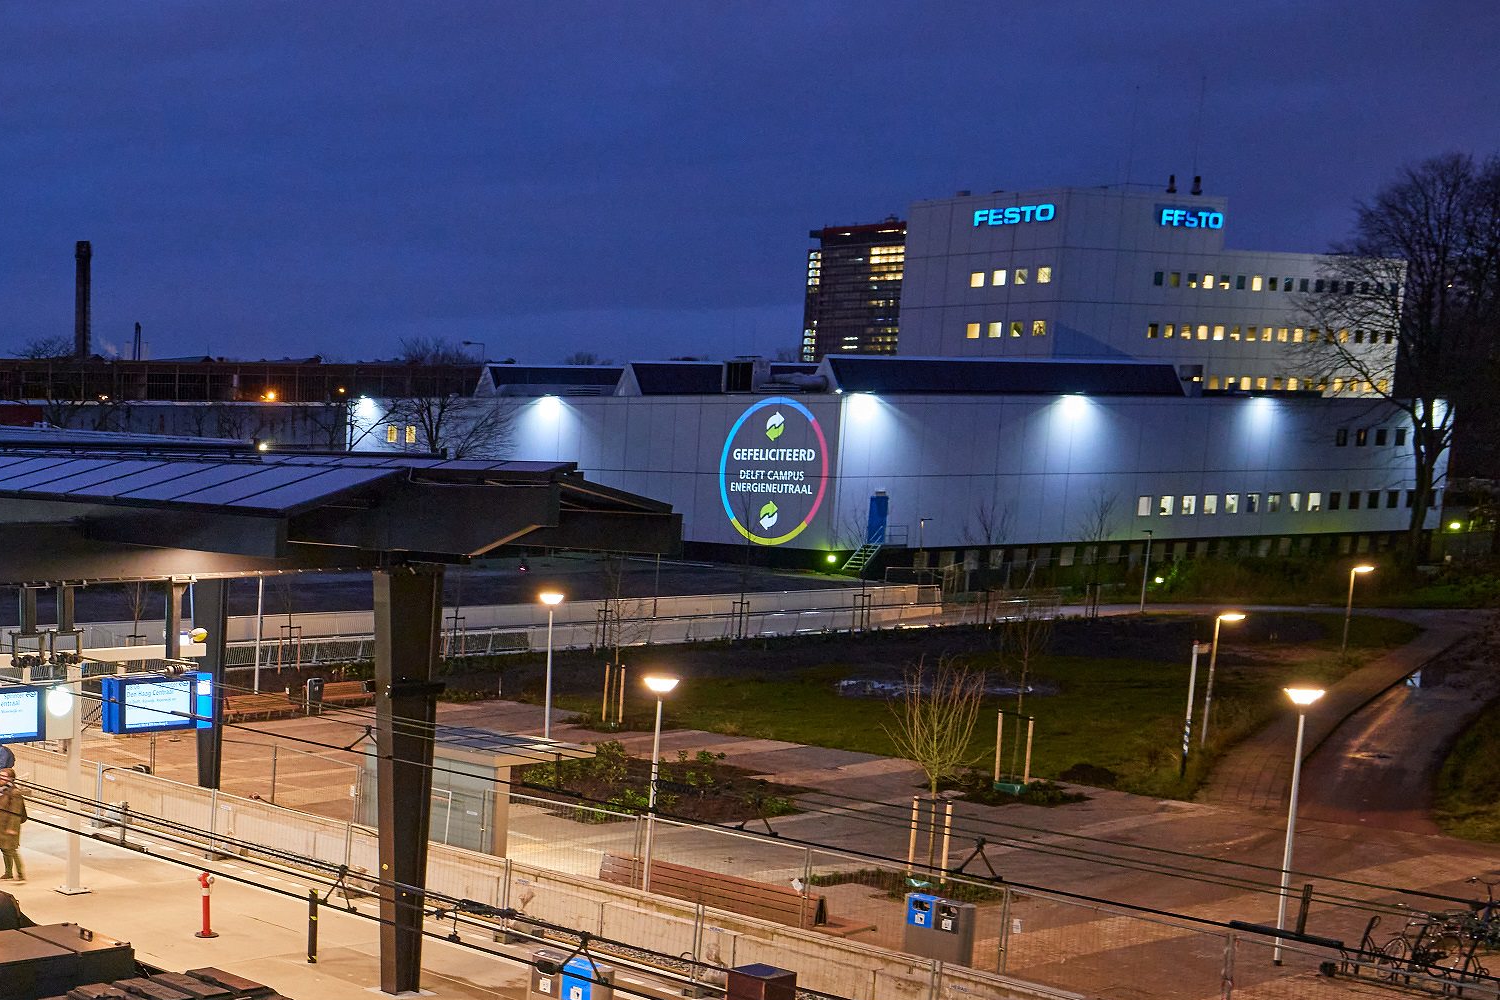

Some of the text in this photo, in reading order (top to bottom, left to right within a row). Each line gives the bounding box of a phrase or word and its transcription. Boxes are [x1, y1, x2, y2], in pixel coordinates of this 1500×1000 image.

[973, 203, 1055, 227] FESTO
[733, 448, 816, 461] GEFELICITEERD
[739, 470, 805, 481] DELFT CAMPUS
[730, 482, 813, 494] ENERGIENEUTRAAL
